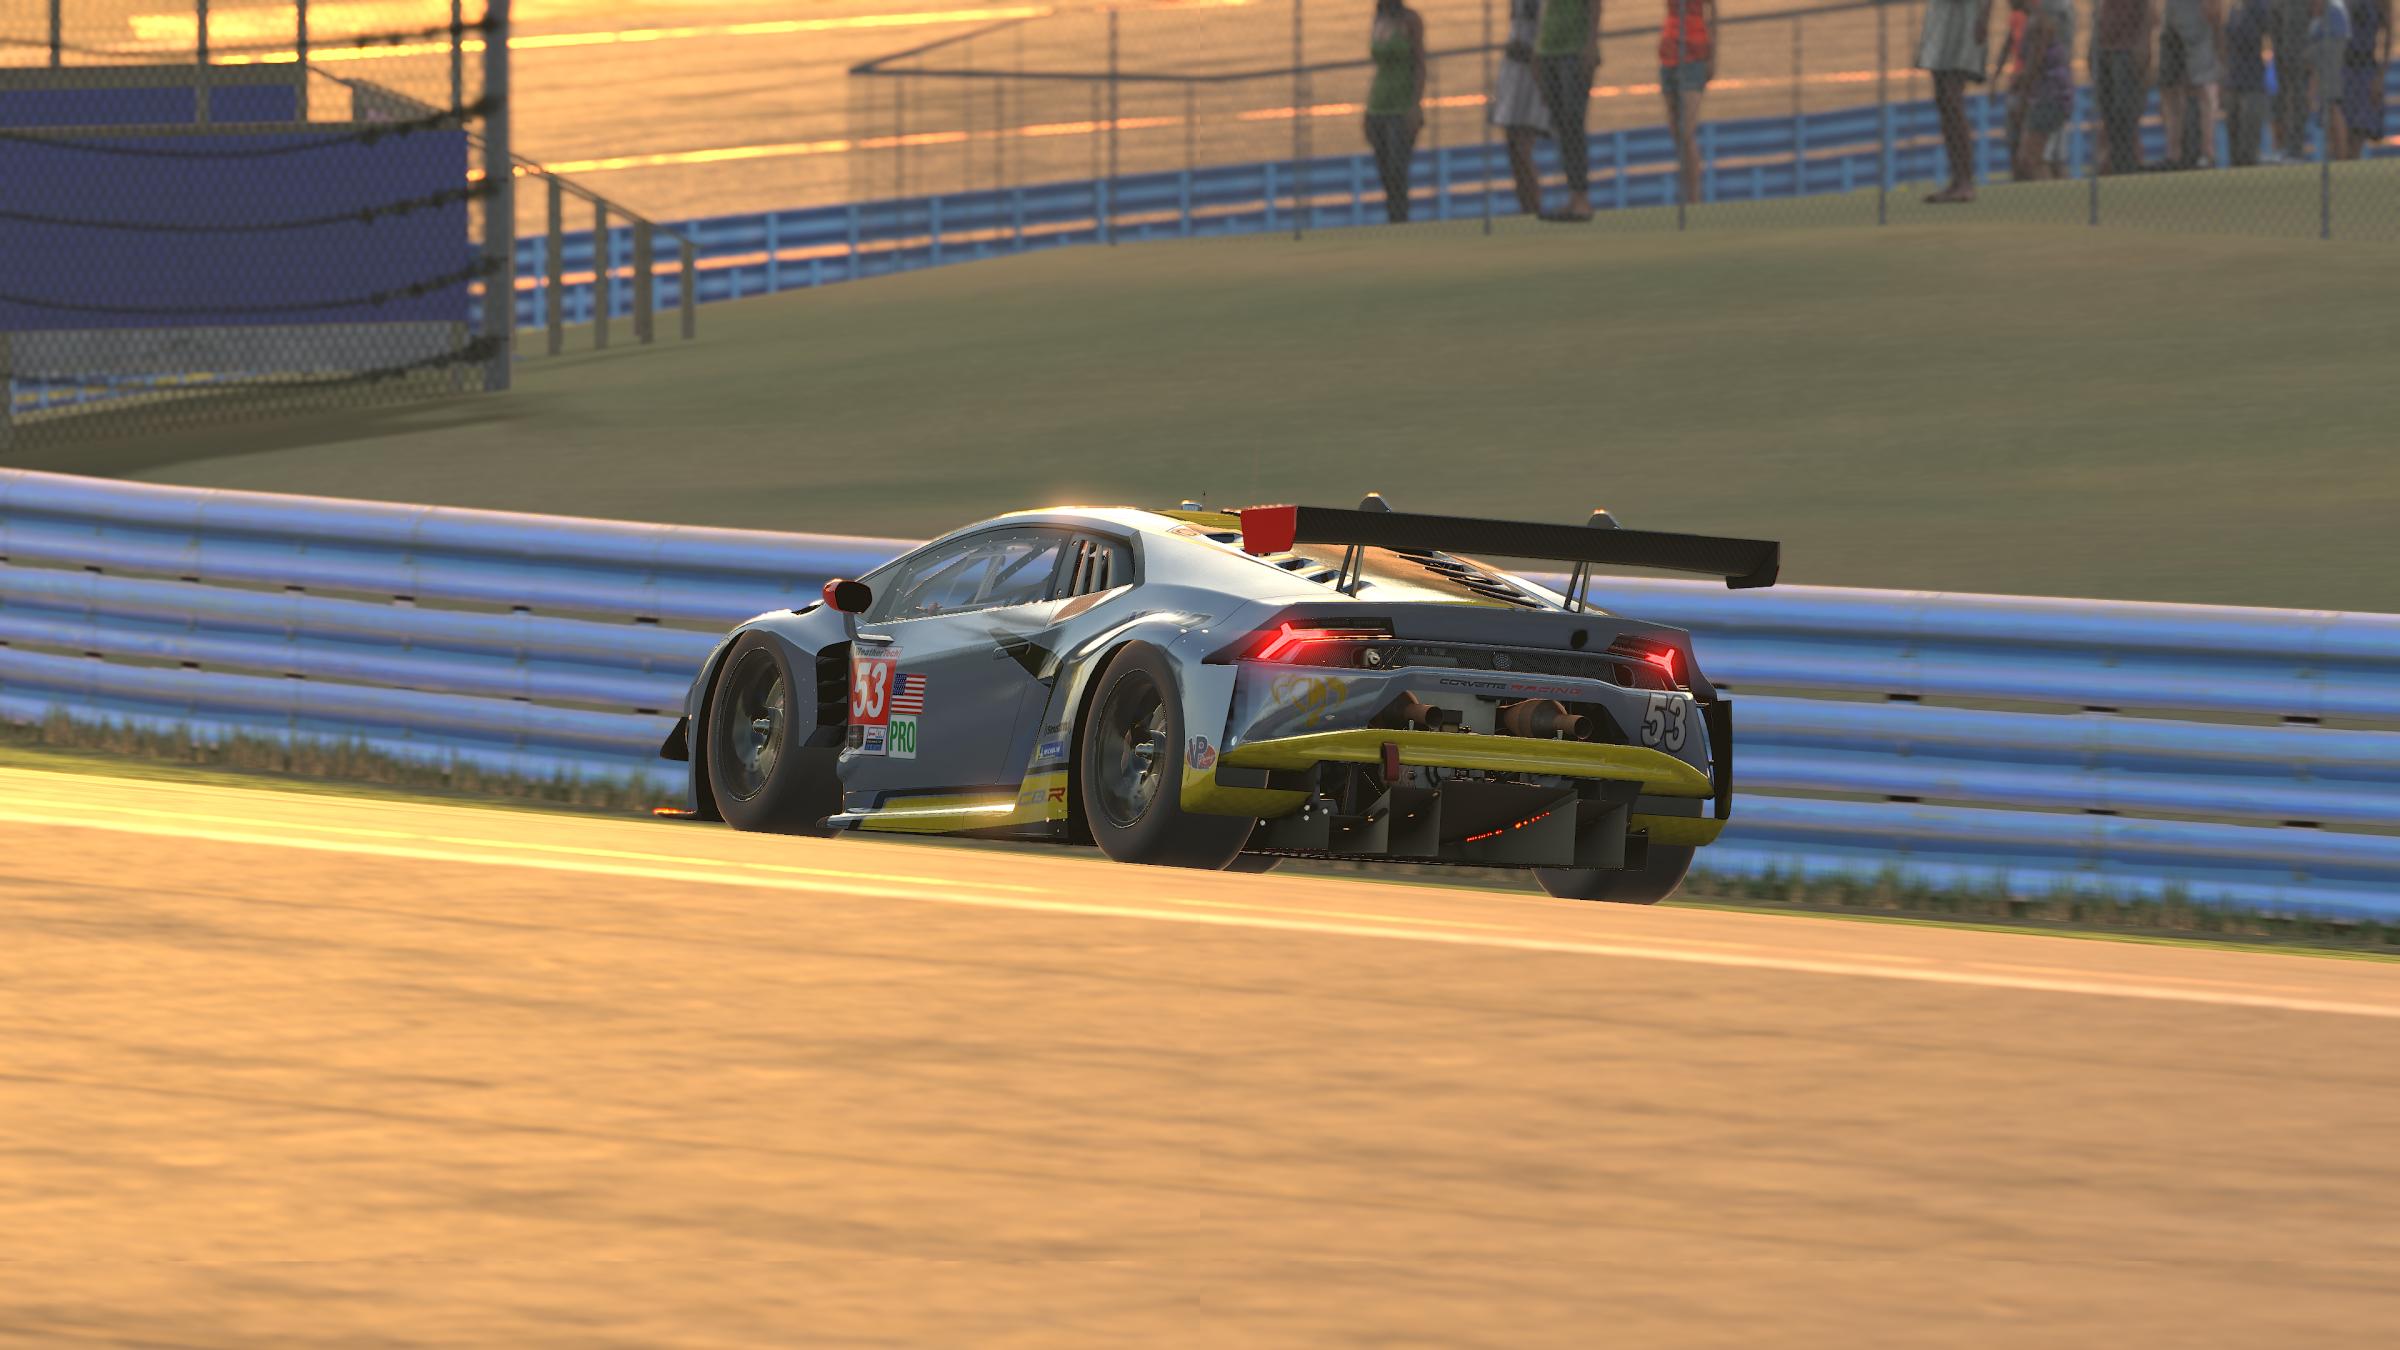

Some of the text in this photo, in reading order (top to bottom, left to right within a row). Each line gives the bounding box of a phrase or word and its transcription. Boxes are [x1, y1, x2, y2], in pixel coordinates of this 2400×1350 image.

[853, 662, 888, 718] 53
[1440, 678, 1584, 696] CORVETTE RACING
[889, 720, 916, 753] PRO
[1641, 691, 1688, 752] 53
[1188, 735, 1208, 769] VP
